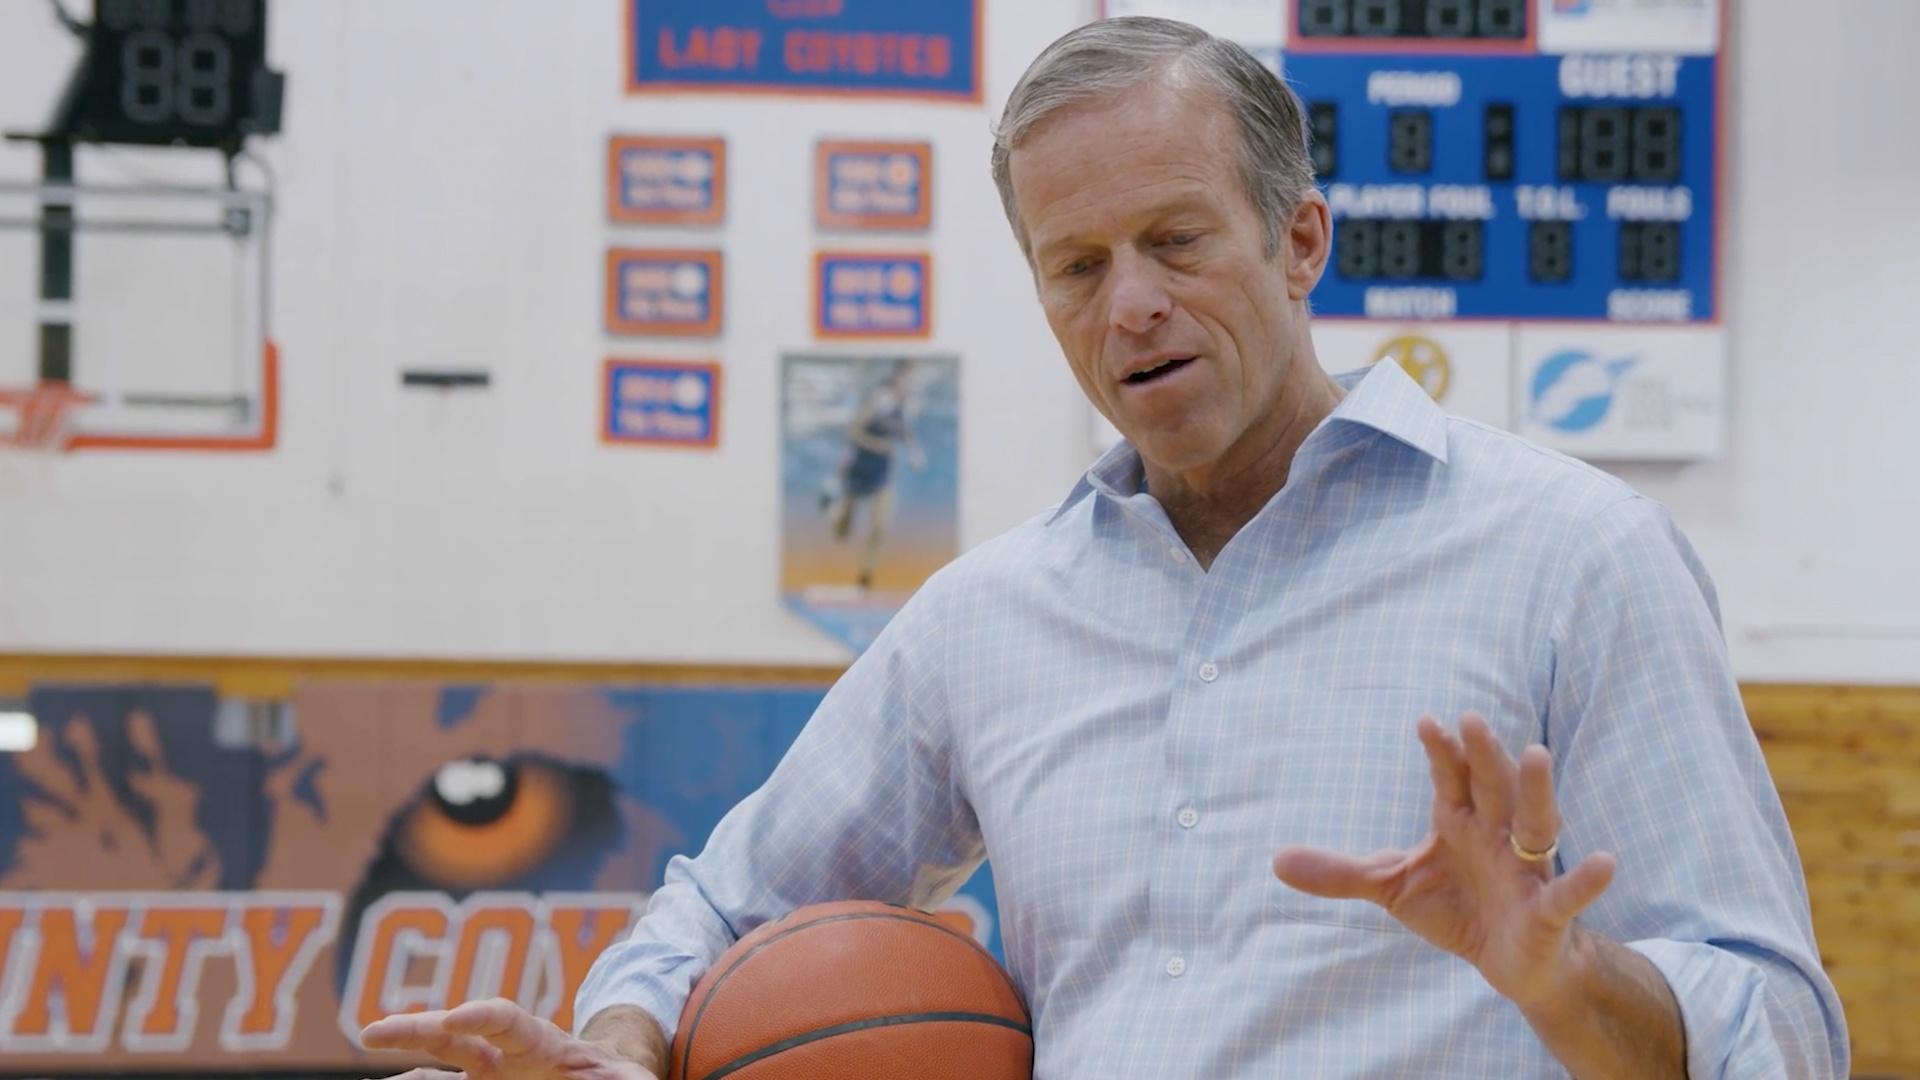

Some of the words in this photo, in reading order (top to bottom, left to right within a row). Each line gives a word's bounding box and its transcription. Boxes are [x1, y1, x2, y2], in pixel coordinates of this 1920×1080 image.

[658, 26, 763, 71] LADY
[1559, 55, 1682, 98] GUEST
[1428, 185, 1494, 219] FOUL
[0, 889, 344, 1054] NTY
